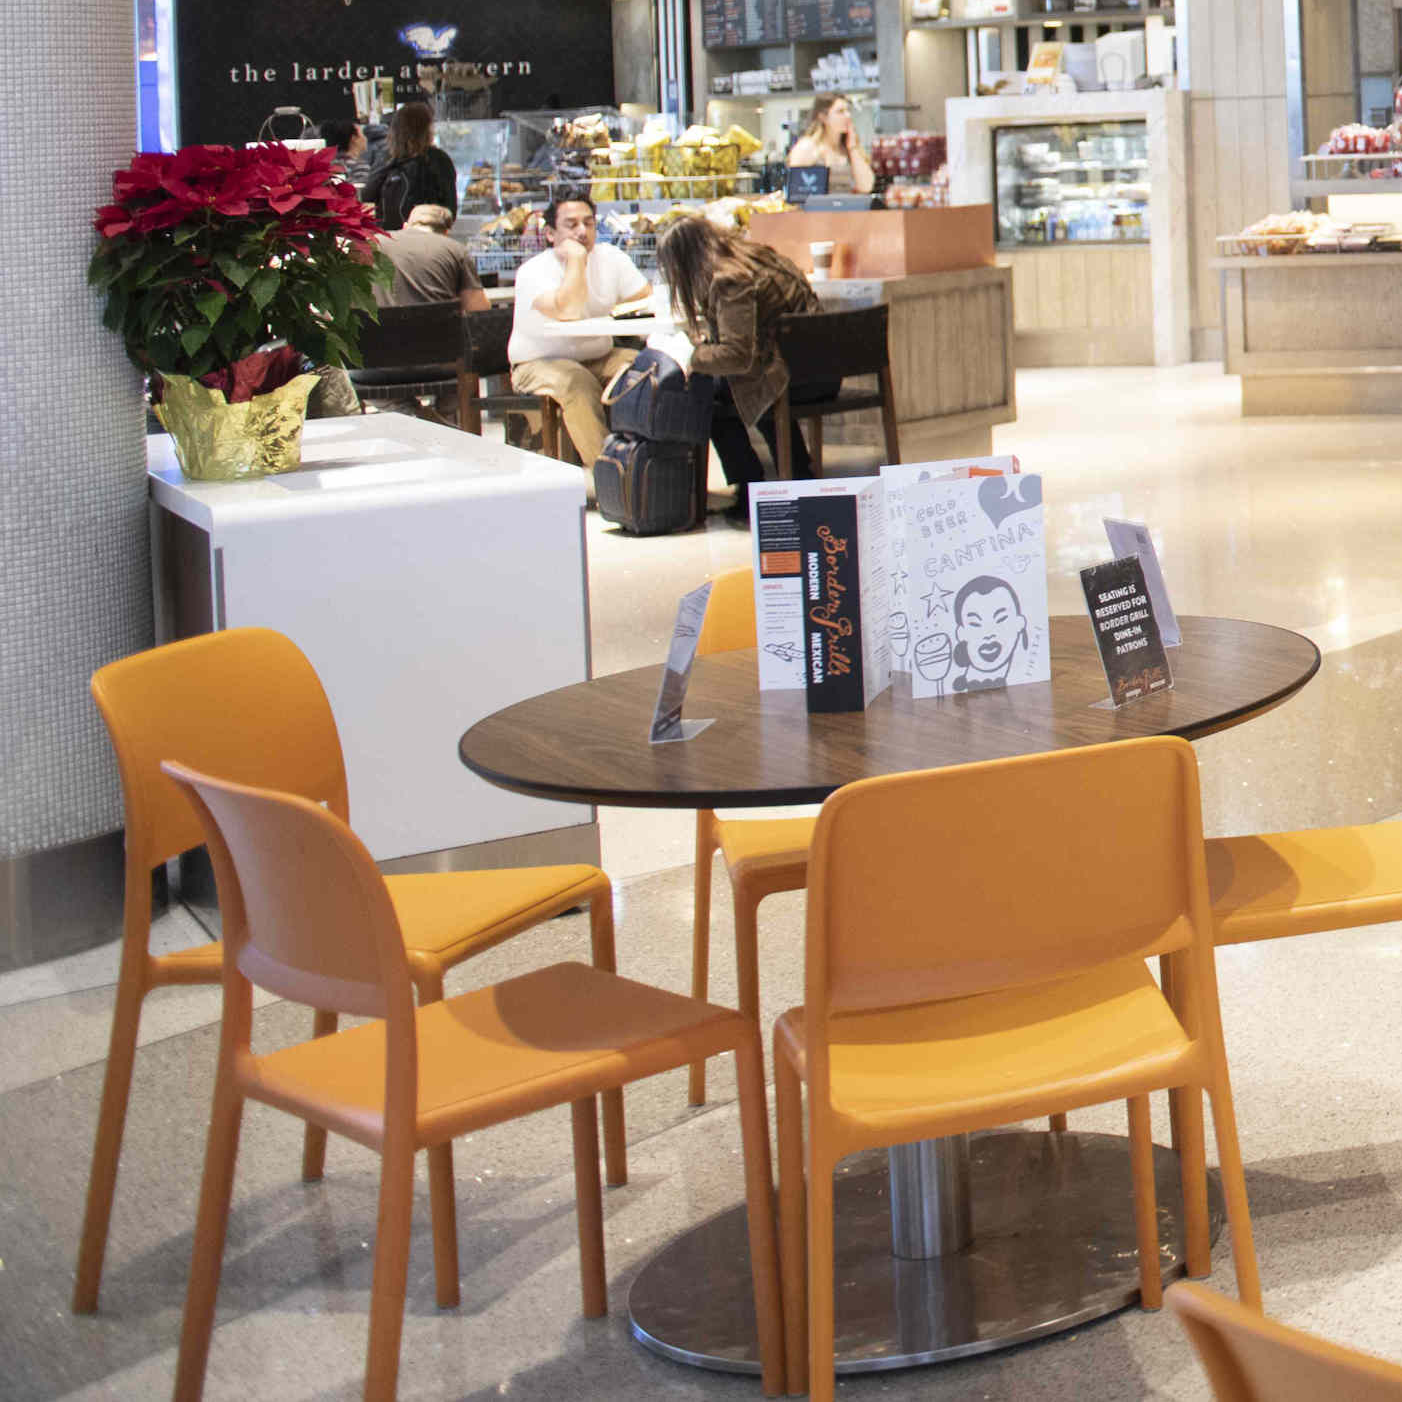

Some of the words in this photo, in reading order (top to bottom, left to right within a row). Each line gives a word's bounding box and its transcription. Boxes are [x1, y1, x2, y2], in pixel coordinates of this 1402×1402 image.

[230, 62, 277, 84] the
[292, 60, 385, 82] larder
[921, 510, 969, 539] BEER
[923, 522, 1036, 578] CANTINA
[807, 551, 821, 601] MODERN
[816, 524, 849, 620] Border
[1095, 599, 1132, 619] RESERVED
[1131, 594, 1148, 608] FOR
[1098, 585, 1129, 604] SEATING
[1128, 584, 1137, 595] IS
[1099, 613, 1130, 632] BORDER
[1129, 608, 1149, 623] GRILL
[1113, 624, 1143, 642] DINE-IN
[1116, 636, 1149, 655] PATRONS
[811, 631, 825, 685] MEXICAN
